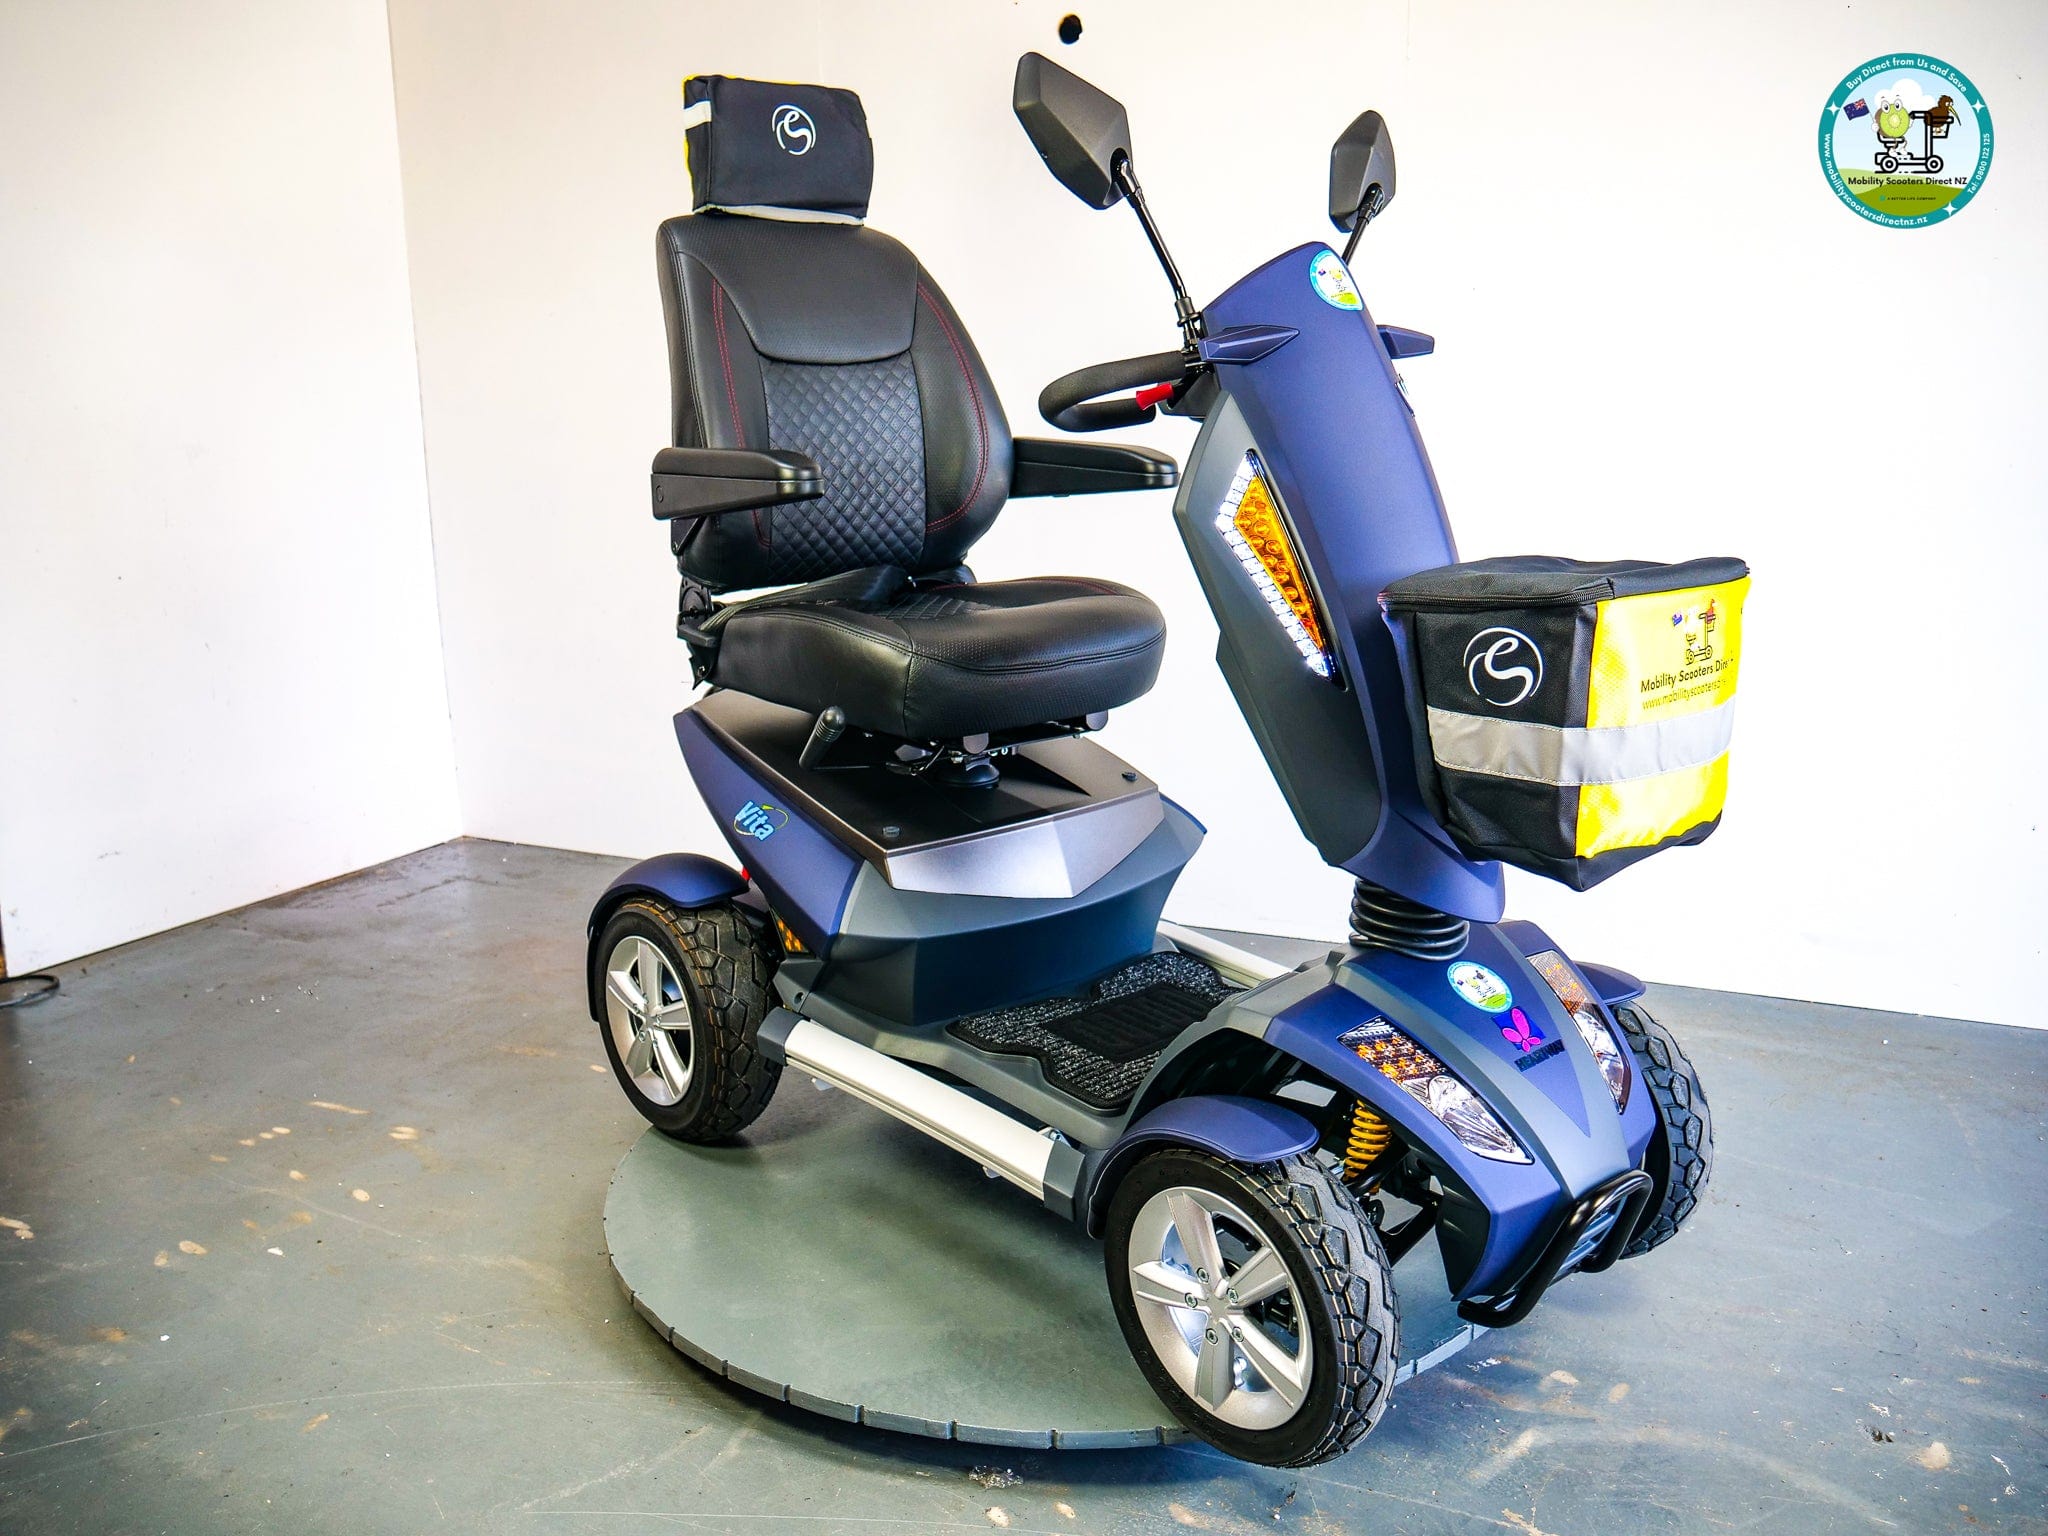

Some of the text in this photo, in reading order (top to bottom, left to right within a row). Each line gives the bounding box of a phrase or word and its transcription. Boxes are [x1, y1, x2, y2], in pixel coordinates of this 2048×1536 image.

[1640, 673, 1676, 693] Mobility
[1678, 665, 1714, 682] Scooters
[735, 800, 776, 841] Vita
